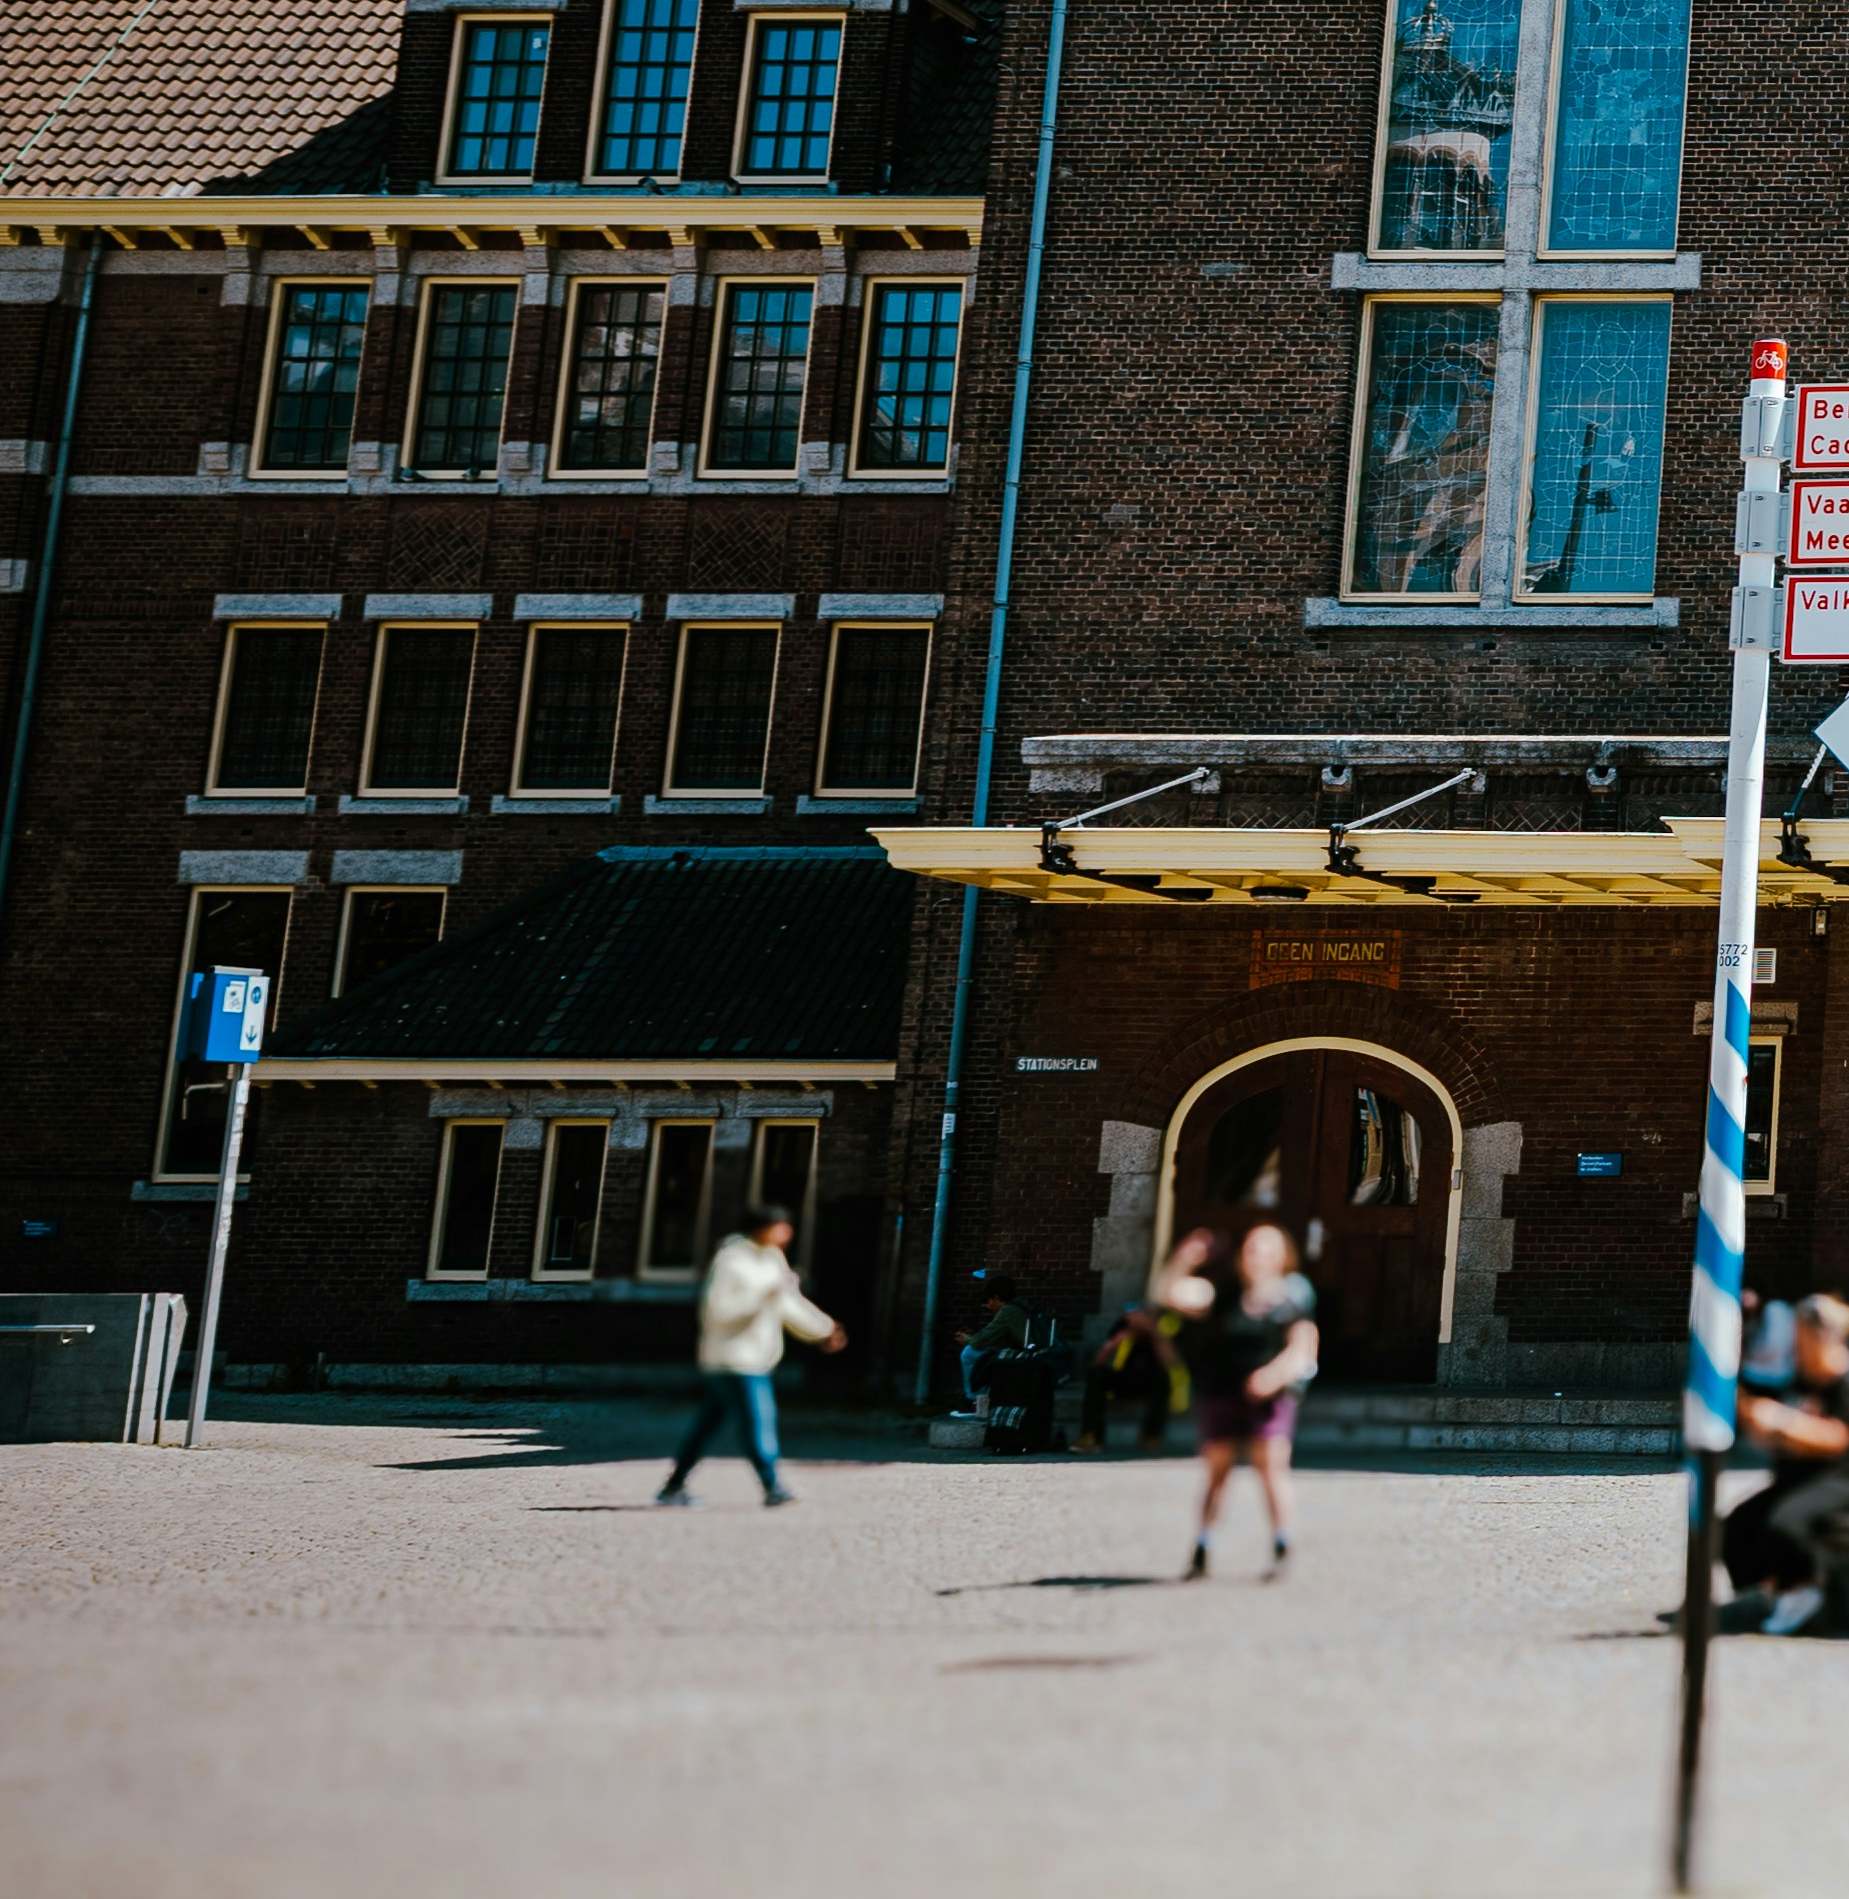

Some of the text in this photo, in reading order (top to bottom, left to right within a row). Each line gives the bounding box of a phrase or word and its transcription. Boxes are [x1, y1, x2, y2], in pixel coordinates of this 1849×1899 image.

[1266, 942, 1386, 961] GEEN INGANG
[1017, 1058, 1098, 1071] STATIONSPLEIN
